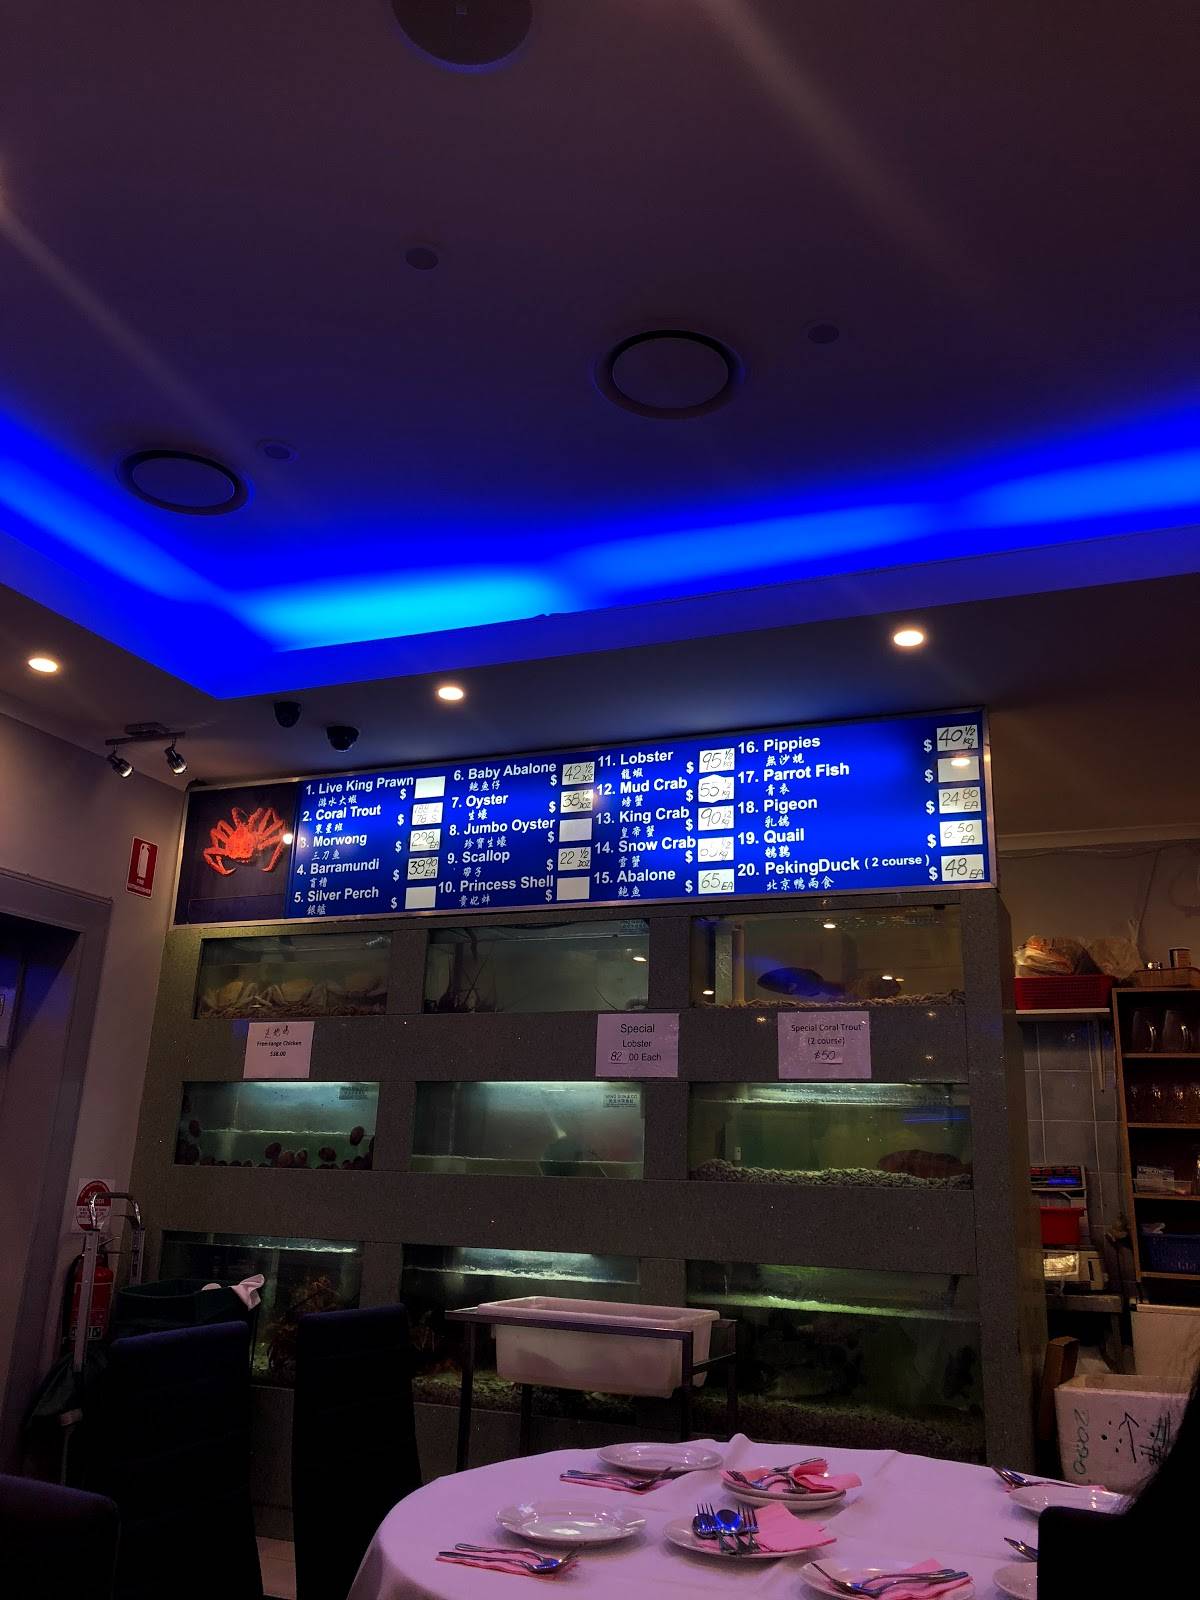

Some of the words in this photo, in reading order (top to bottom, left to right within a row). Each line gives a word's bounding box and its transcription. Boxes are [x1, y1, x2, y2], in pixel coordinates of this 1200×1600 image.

[738, 741, 759, 754] 16.
[764, 736, 821, 753] Pippies
[923, 738, 933, 753] $
[938, 728, 963, 747] 40
[598, 754, 616, 767] 11.
[620, 751, 673, 765] Lobster
[686, 761, 694, 774] $
[702, 752, 722, 770] 95
[454, 770, 464, 781] 6.
[469, 767, 500, 780] Baby
[503, 763, 556, 777] Abalone
[550, 774, 557, 787] $
[564, 765, 581, 781] 42
[737, 770, 759, 784] 17.
[763, 766, 811, 782] Parrot
[815, 762, 850, 777] Fish
[924, 768, 934, 783] $
[306, 784, 315, 795] 1.
[319, 783, 342, 794] Live
[346, 780, 373, 792] King
[377, 776, 414, 788] Prawn
[400, 788, 406, 800] $
[596, 783, 616, 796] 12.
[620, 780, 649, 794] Mud
[654, 777, 688, 791] Crab
[686, 789, 694, 803] $
[700, 783, 720, 797] 55
[451, 797, 462, 808] 7.
[466, 794, 508, 810] Oyster
[549, 801, 556, 813] $
[563, 793, 580, 807] 38
[738, 801, 759, 814] 18.
[763, 798, 818, 814] Pigeon
[925, 800, 935, 815] $
[942, 791, 960, 806] 24
[963, 801, 979, 810] EA
[303, 811, 312, 821] 2.
[316, 807, 347, 820] Coral
[350, 804, 382, 817] Trout
[397, 814, 404, 826] $
[596, 812, 615, 825] 13.
[619, 810, 651, 825] King
[656, 806, 690, 820] Crab
[685, 818, 693, 832] $
[701, 808, 721, 827] 90
[449, 824, 460, 836] 8.
[464, 821, 507, 835] Jumbo
[512, 818, 555, 833] Oyster
[927, 833, 937, 848] $
[943, 825, 953, 839] 6
[957, 823, 974, 833] 50
[301, 837, 310, 848] 3.
[313, 834, 367, 848] Morwong
[547, 831, 554, 843] $
[737, 831, 759, 845] 19.
[763, 827, 805, 843] Quail
[960, 835, 975, 844] EA
[395, 841, 402, 853] $
[595, 842, 614, 854] 14.
[619, 840, 658, 853] Snow
[661, 836, 696, 850] Crab
[447, 853, 458, 864] 9.
[462, 849, 510, 863] Scallop
[546, 859, 553, 871] $
[560, 850, 575, 865] 22
[685, 850, 693, 864] $
[297, 865, 306, 875] 4.
[310, 858, 380, 875] Barramundi
[424, 869, 436, 877] EA
[737, 863, 760, 877] 20.
[765, 857, 860, 876] PekingDuck
[881, 856, 923, 867] course
[928, 866, 938, 881] $
[945, 857, 968, 878] 48
[969, 869, 984, 879] EA
[393, 869, 400, 882] $
[438, 881, 456, 893] 10.
[460, 878, 516, 892] Princess
[520, 875, 554, 889] Shell
[594, 871, 613, 884] 15.
[617, 869, 676, 883] Abalone
[685, 879, 693, 893] $
[702, 872, 721, 889] 65
[721, 881, 734, 890] EA
[294, 892, 304, 903] 5.
[308, 889, 341, 902] Silver
[344, 886, 379, 899] Perch
[391, 897, 398, 909] $
[545, 889, 552, 902] $
[620, 1024, 655, 1034] Special
[791, 1024, 817, 1032] Special
[820, 1023, 839, 1031] Coral
[841, 1023, 862, 1031] Trout
[622, 1040, 652, 1048] Lobster
[641, 1052, 662, 1061] Each
